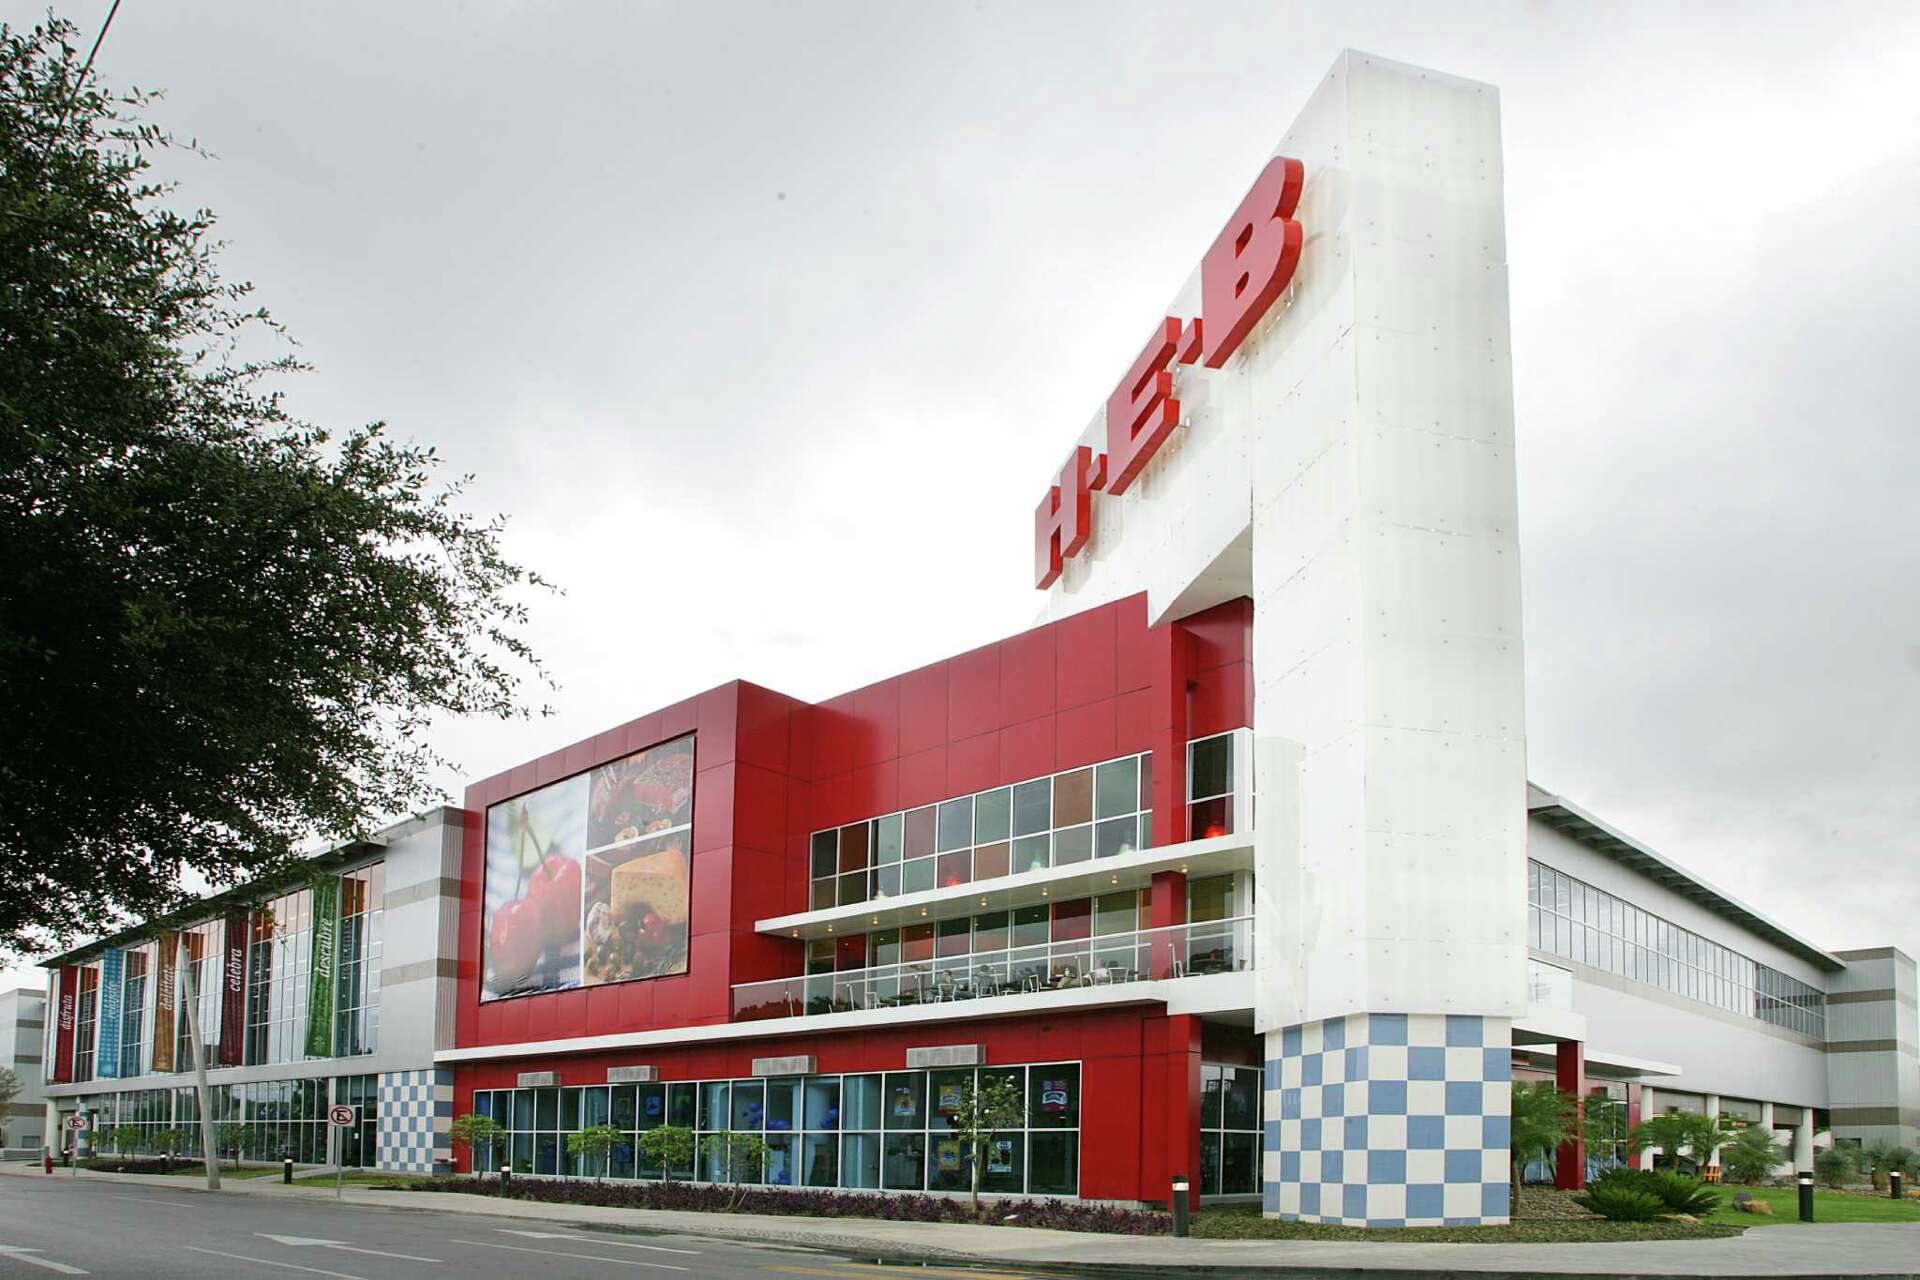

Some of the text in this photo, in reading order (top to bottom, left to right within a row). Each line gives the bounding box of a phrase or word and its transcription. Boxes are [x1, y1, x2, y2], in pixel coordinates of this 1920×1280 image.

[1034, 155, 1304, 590] H-E-B
[226, 947, 243, 992] celebra
[316, 918, 333, 978] descubre
[59, 994, 74, 1030] disfruta
